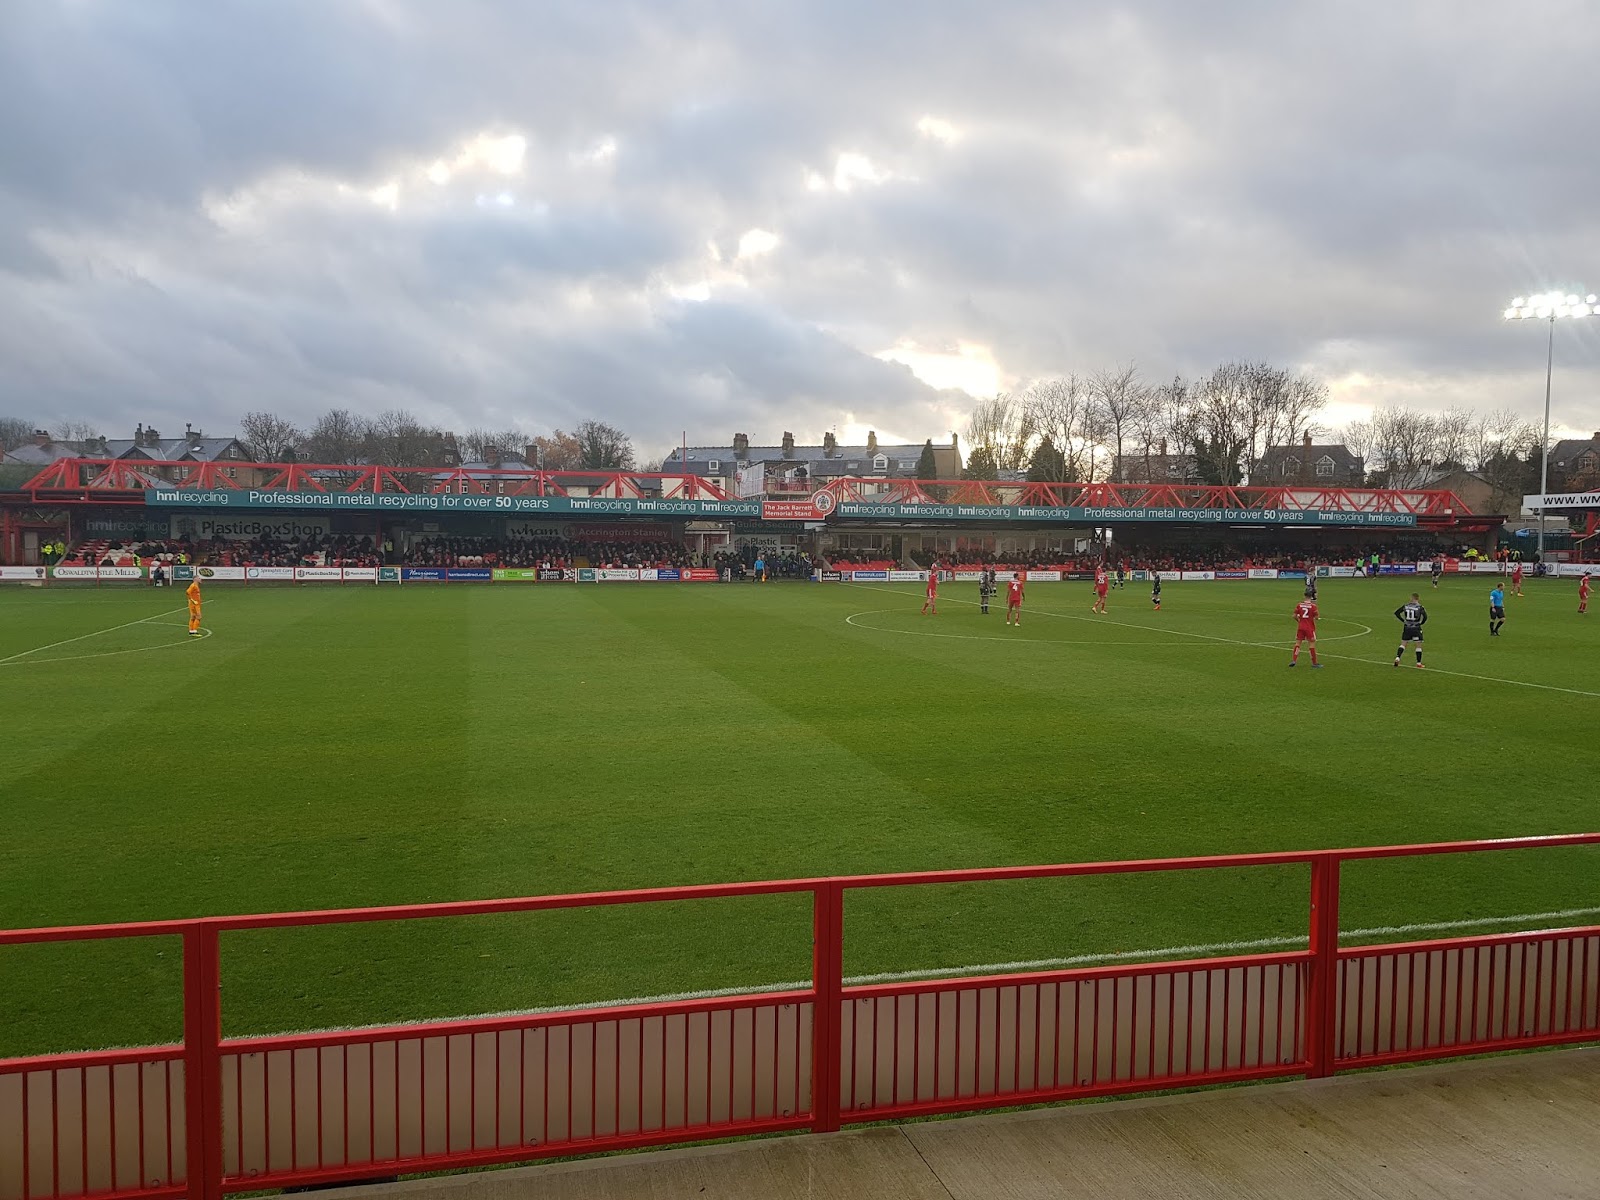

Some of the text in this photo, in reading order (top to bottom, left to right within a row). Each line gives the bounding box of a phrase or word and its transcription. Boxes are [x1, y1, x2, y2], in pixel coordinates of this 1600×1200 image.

[156, 490, 228, 504] hmlrecycling
[249, 491, 549, 511] Professional metal recycling for over 50 years
[570, 499, 759, 514] hmlrecycling hmlrecycling hmlrecycling
[841, 504, 1070, 519] hmlrecycling hmlrecycling hmlrecycling hmlrecycling
[1084, 507, 1304, 522] Professional metal recycling for over 50 years
[1318, 512, 1413, 524] hmlrecycling hmlrecycling
[201, 521, 323, 538] PlasticBoxShop
[510, 523, 559, 537] wham
[736, 520, 804, 531] Guide Security
[579, 528, 668, 539] Accrington Stanley
[750, 537, 778, 546] Plastic
[1012, 583, 1018, 591] 4
[1302, 607, 1309, 618] 2
[1405, 609, 1415, 621] 11
